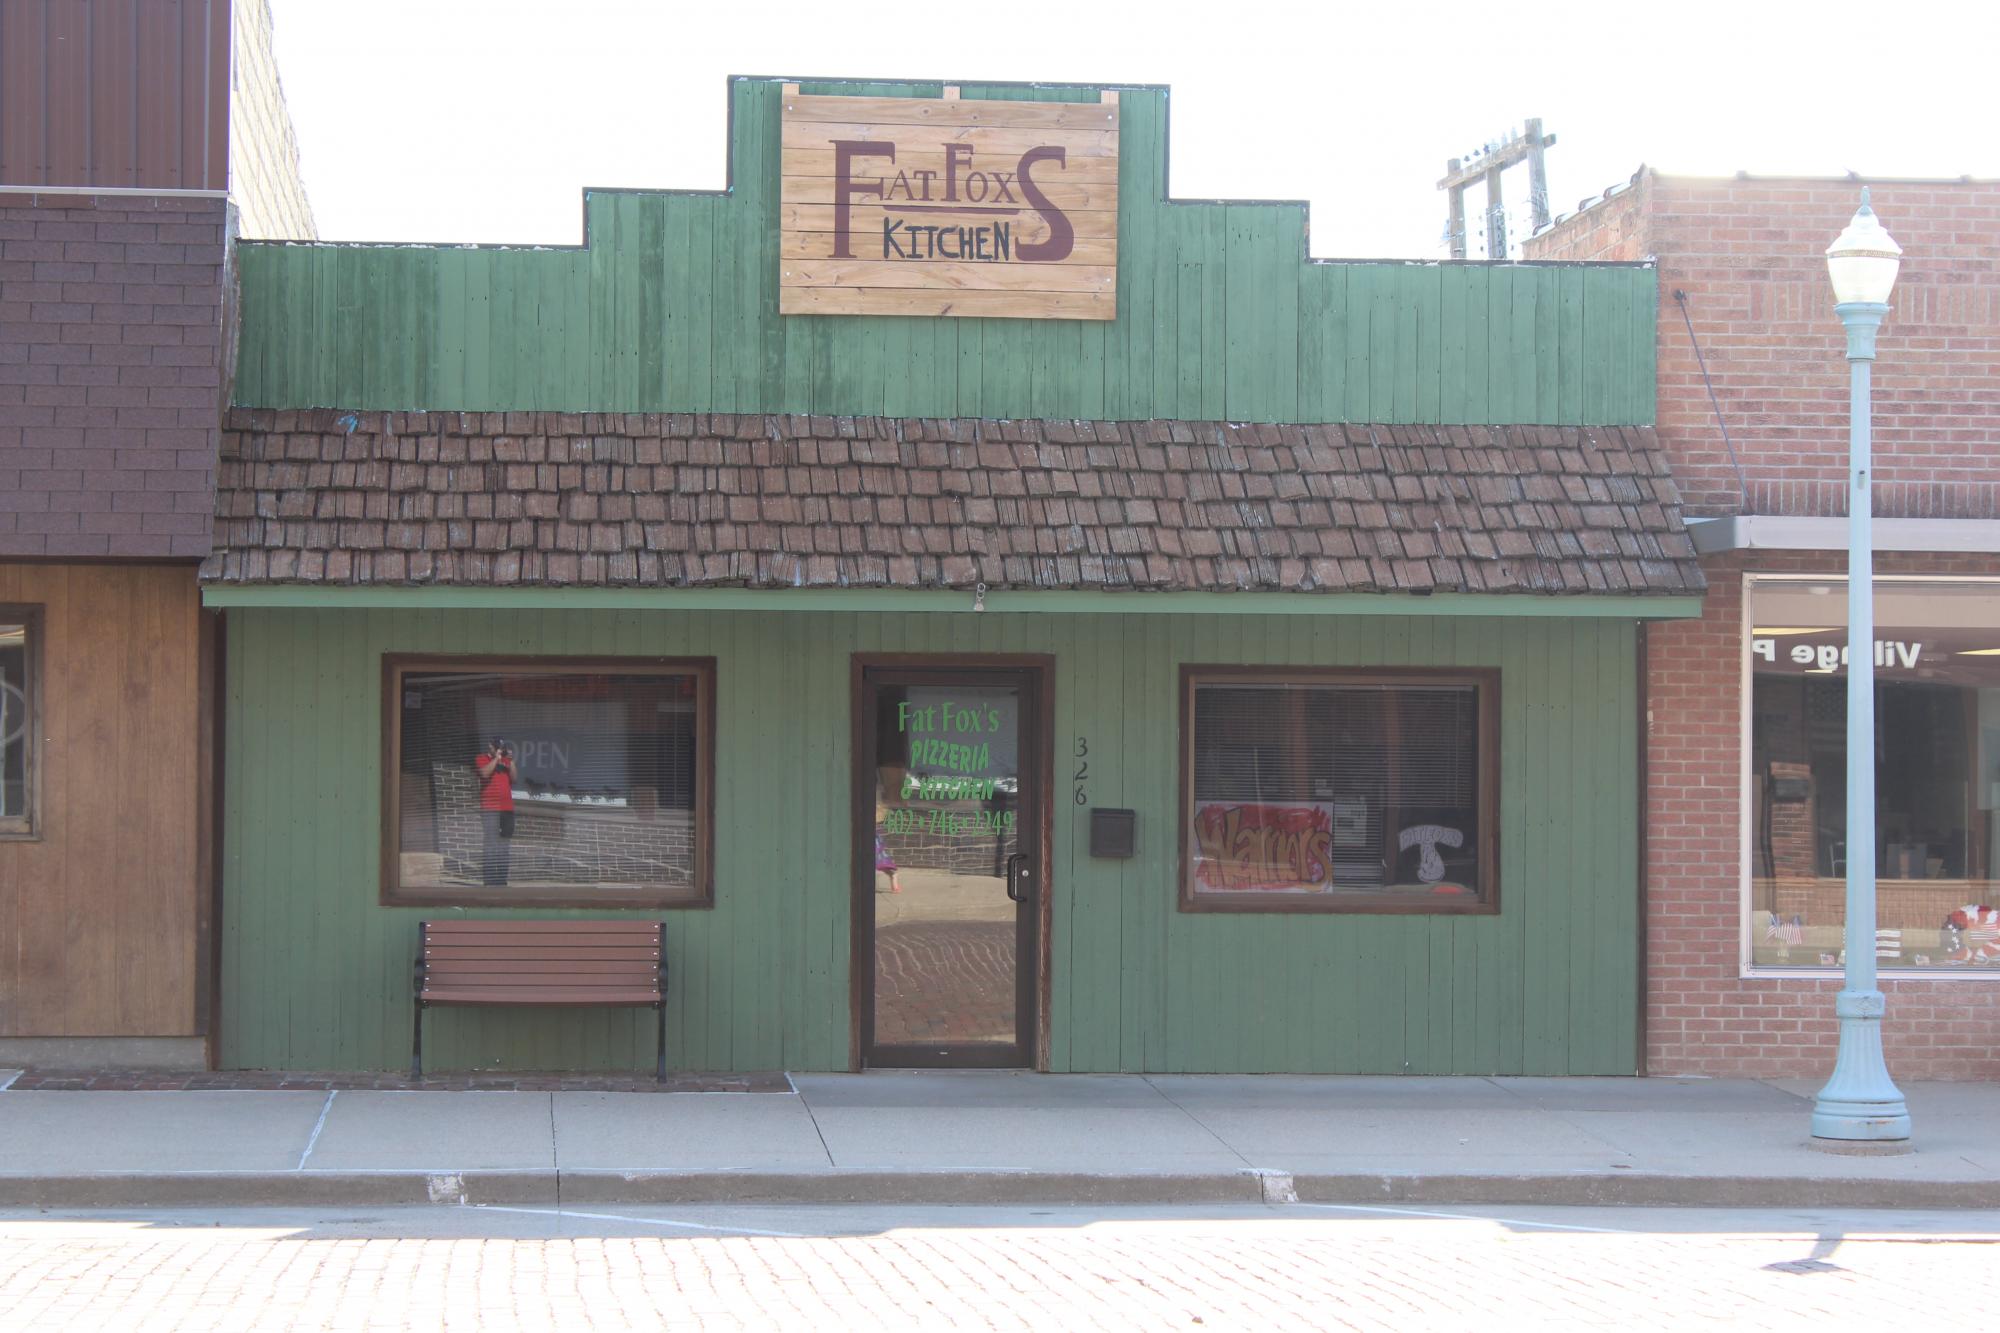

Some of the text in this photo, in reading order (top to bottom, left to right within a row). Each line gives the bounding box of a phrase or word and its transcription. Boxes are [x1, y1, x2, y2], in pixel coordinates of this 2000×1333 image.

[883, 216, 1010, 262] KITCHEN
[897, 701, 1000, 732] Fat Fox's
[910, 738, 990, 773] PIZZERIA
[918, 776, 996, 801] KITCHEN
